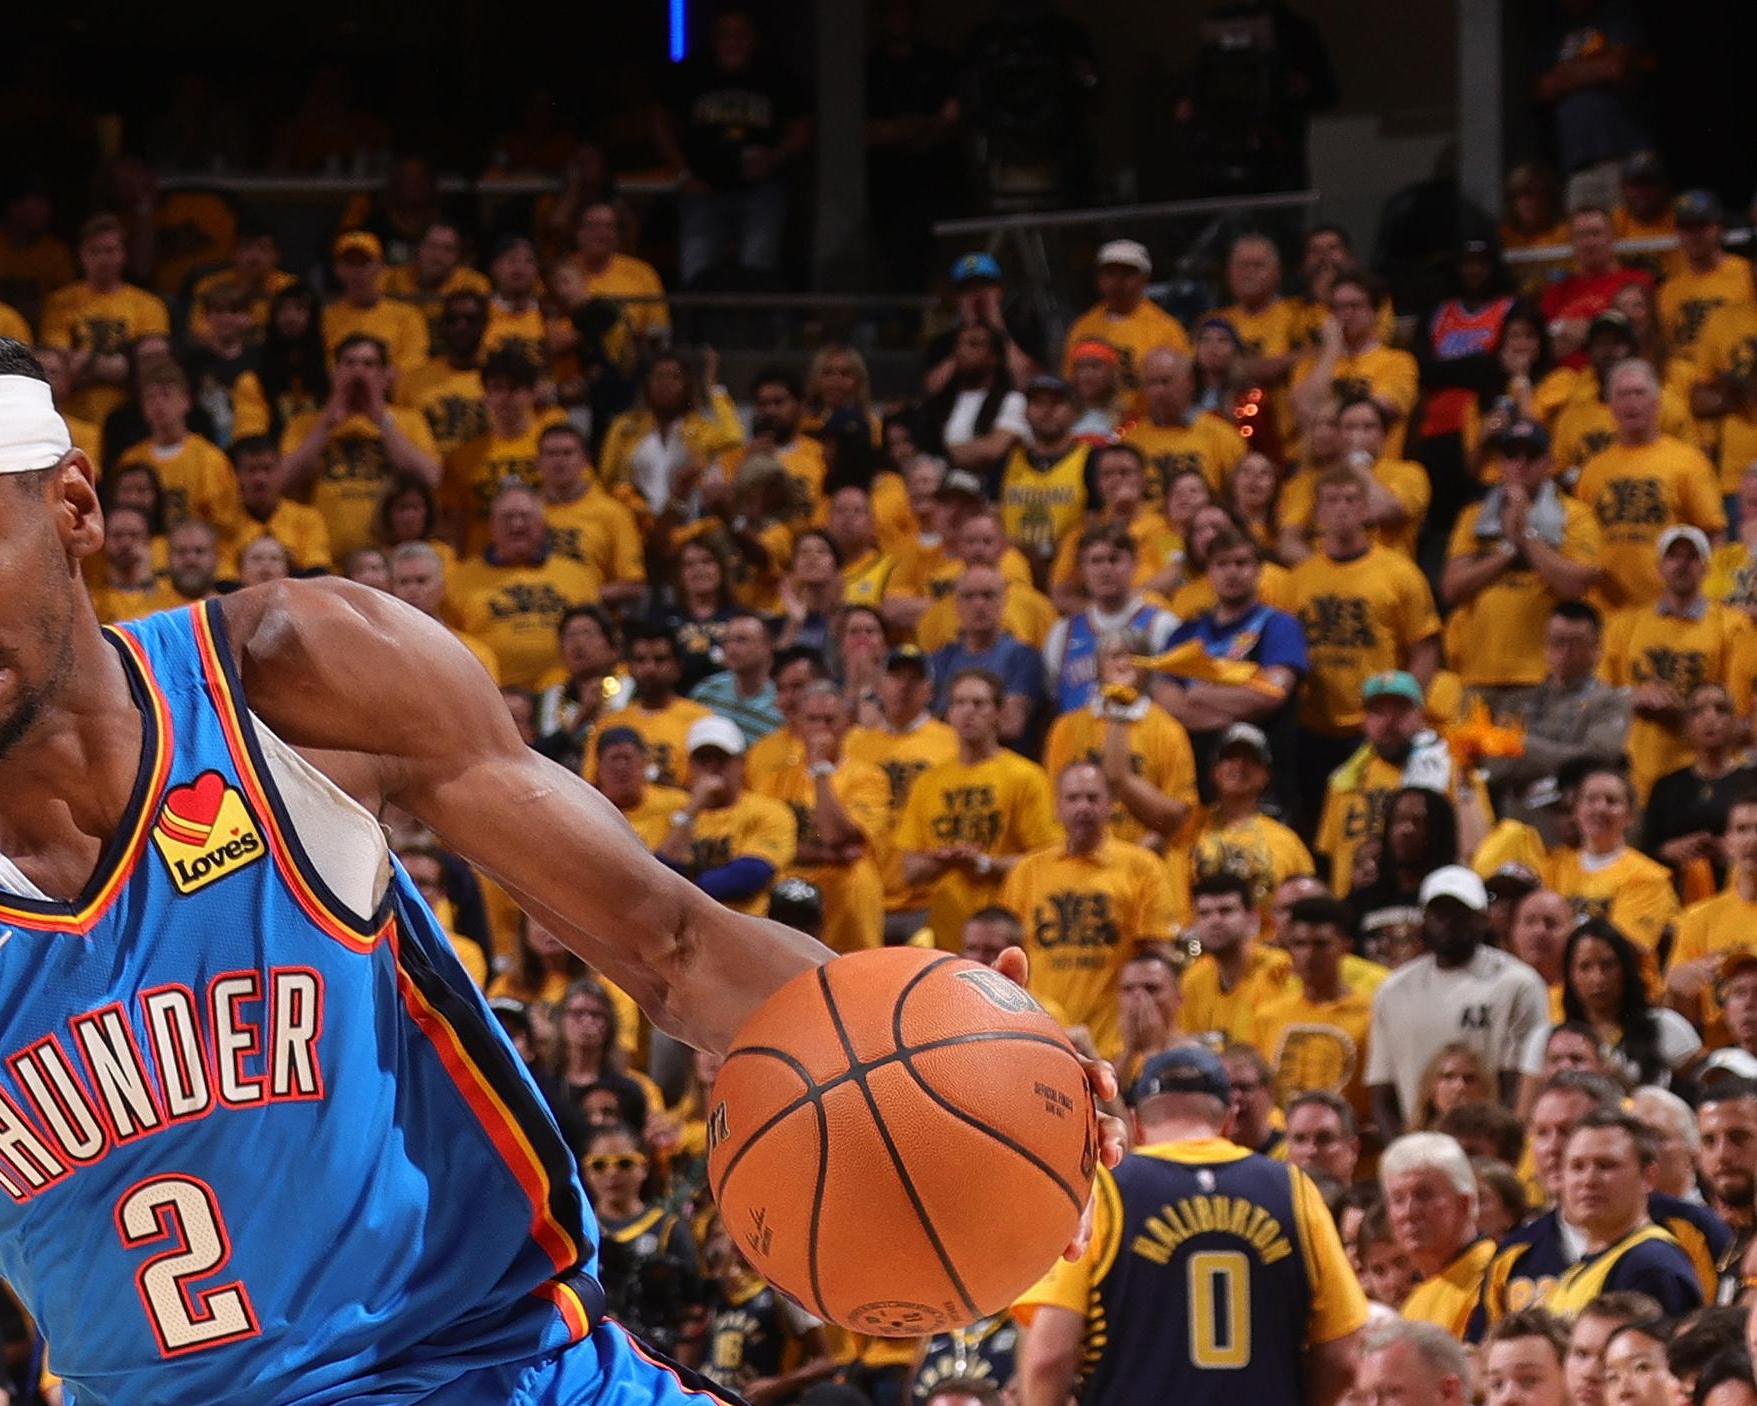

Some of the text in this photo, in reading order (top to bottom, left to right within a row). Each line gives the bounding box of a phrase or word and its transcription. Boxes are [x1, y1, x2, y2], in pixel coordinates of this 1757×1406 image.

[115, 1172, 263, 1358] 2
[1131, 1194, 1293, 1265] HALIBURTON
[1187, 1250, 1252, 1370] 0
